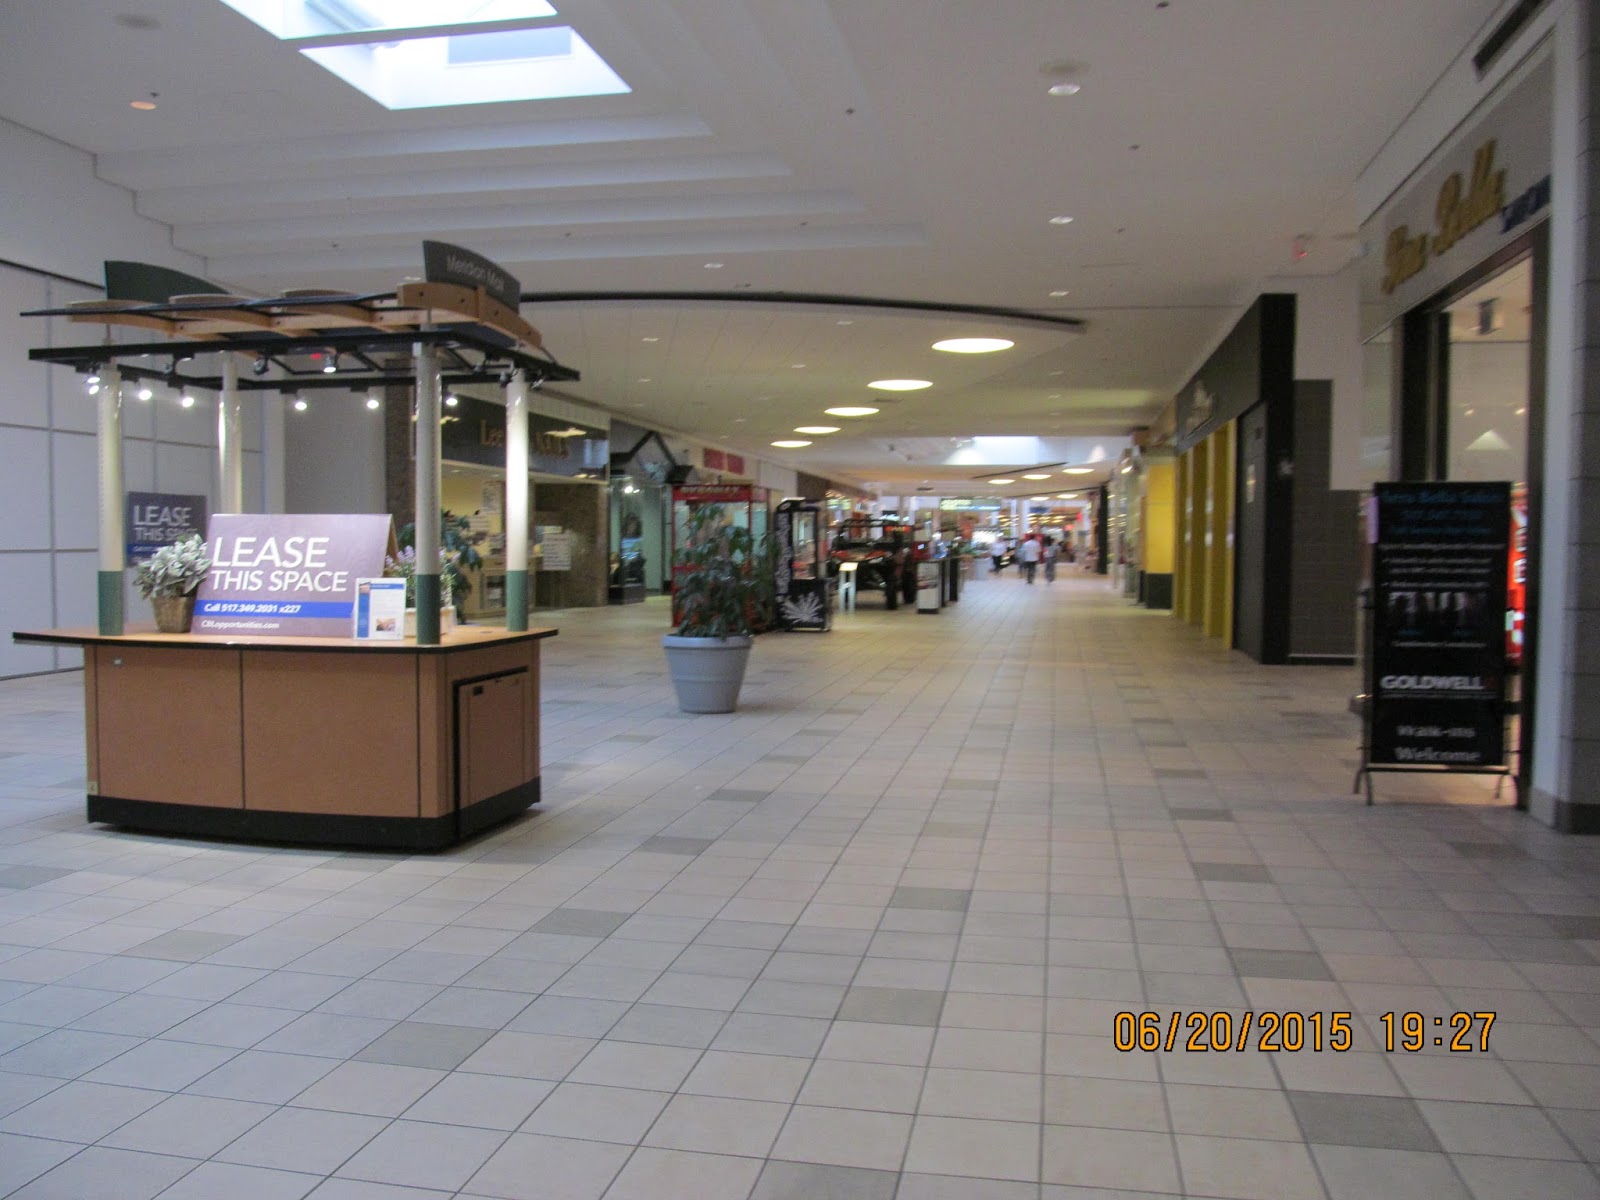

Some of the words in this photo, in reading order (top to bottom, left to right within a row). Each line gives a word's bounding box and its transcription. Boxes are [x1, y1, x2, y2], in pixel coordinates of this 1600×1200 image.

[133, 505, 192, 527] LEASE
[134, 527, 164, 541] THIS
[211, 536, 330, 568] LEASE
[210, 570, 264, 591] THIS
[268, 570, 349, 592] SPACE
[203, 603, 221, 612] Call
[1380, 675, 1485, 690] GOLDWELL
